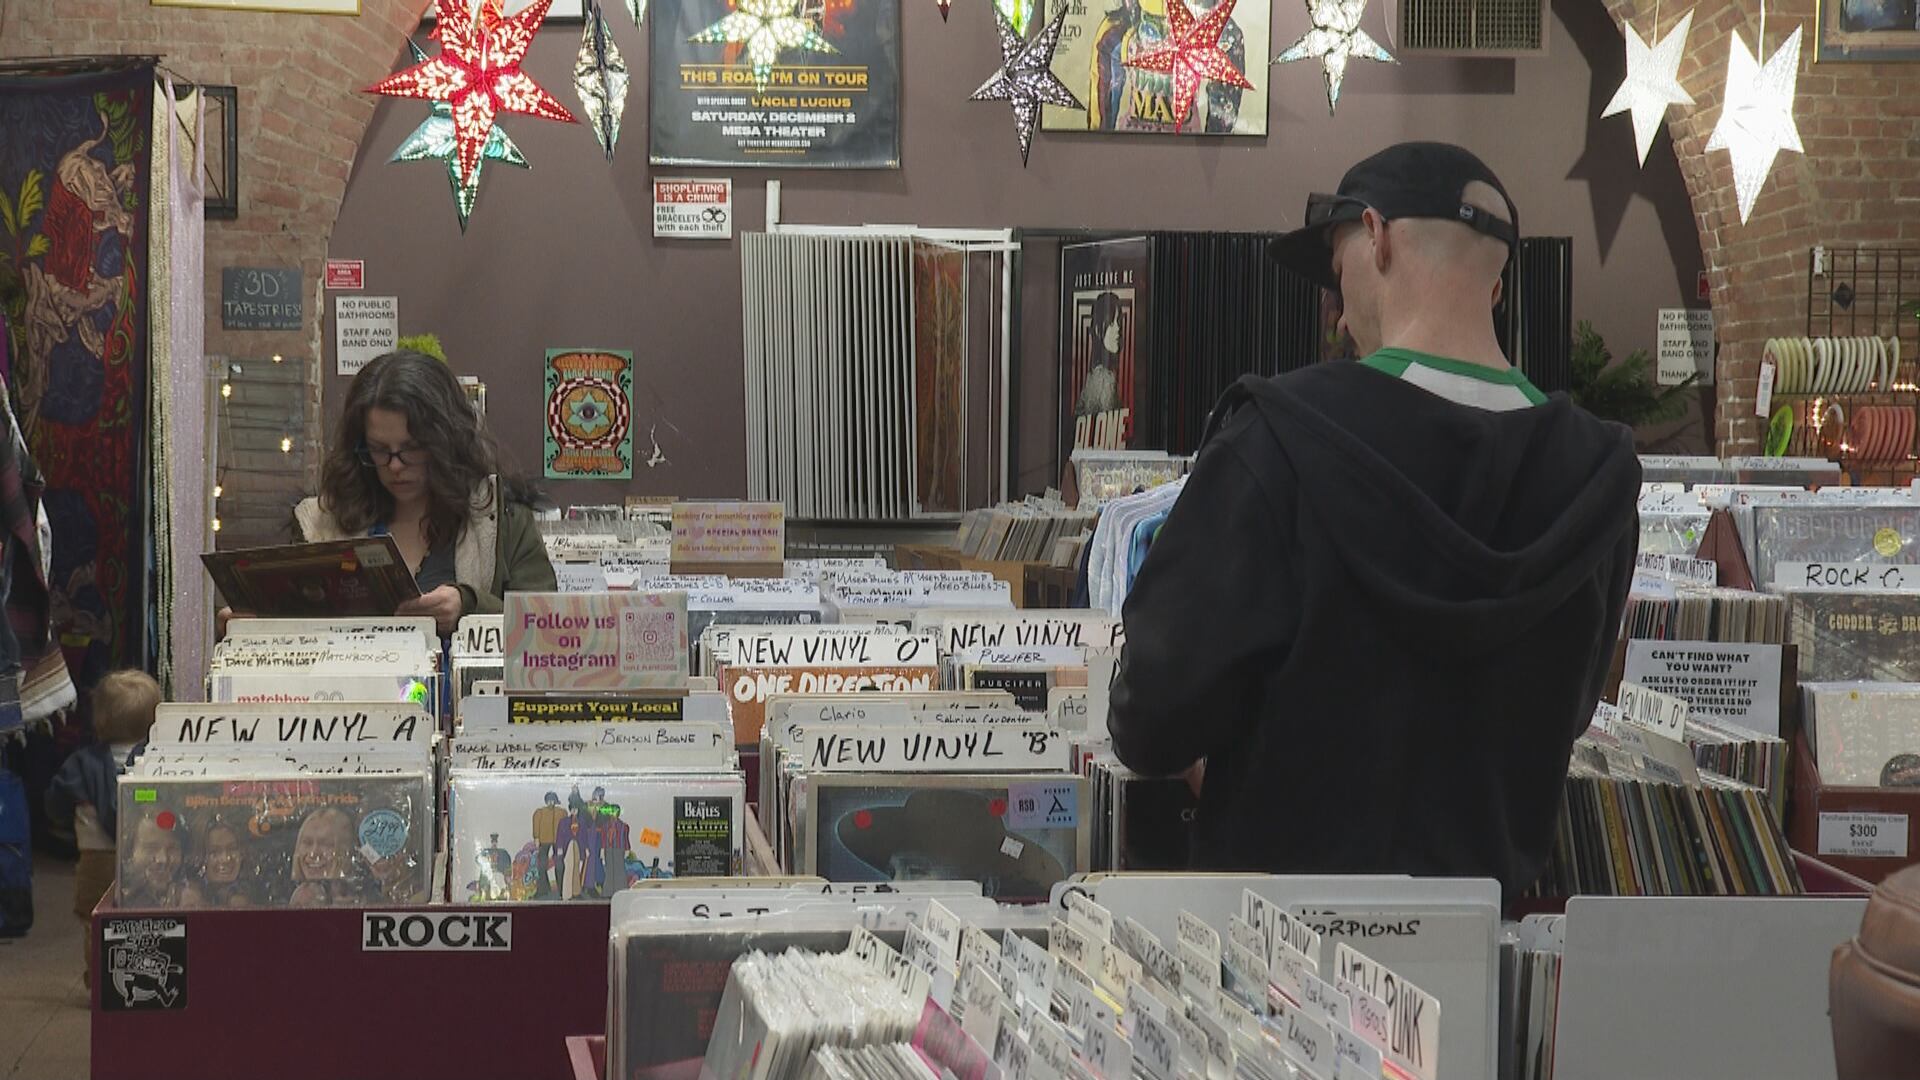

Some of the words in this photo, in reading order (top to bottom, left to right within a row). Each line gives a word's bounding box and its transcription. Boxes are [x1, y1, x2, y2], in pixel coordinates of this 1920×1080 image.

[680, 70, 717, 83] THIS
[722, 71, 766, 84] ROA
[771, 72, 793, 84] I'M
[798, 73, 820, 84] ON
[825, 73, 868, 85] TOUR
[801, 97, 851, 108] LUCIUS
[692, 112, 767, 123] SATURDAY,
[770, 112, 844, 123] DECEMBER
[722, 126, 761, 136] MESA
[764, 126, 825, 137] THEATER
[660, 184, 724, 193] SHOPLIFTING
[664, 194, 673, 202] IS
[676, 194, 683, 202] A
[687, 194, 719, 202] CRIME
[657, 214, 700, 222] BRACELETS
[244, 270, 280, 297] 3D
[1075, 273, 1091, 288] JUST
[1096, 271, 1118, 286] LEAVE
[1123, 270, 1133, 283] ME
[342, 301, 356, 309] NO
[359, 301, 391, 309] PUBLIC
[1663, 312, 1675, 320] NO
[1678, 312, 1709, 320] PUBLIC
[343, 328, 369, 336] STAFF
[373, 328, 391, 336] AND
[1660, 323, 1712, 331] BATHROOMS
[1074, 408, 1129, 450] ALONE
[1806, 564, 1869, 587] ROCK
[523, 612, 590, 630] Follow
[595, 615, 616, 630] us
[559, 635, 581, 648] on
[950, 624, 1005, 652] NEW
[1016, 623, 1088, 647] VINYL
[738, 637, 793, 664] NEW
[803, 636, 872, 663] VINYL
[1651, 650, 1685, 660] CAN'T
[1688, 651, 1714, 661] FIND
[1716, 652, 1750, 663] WHAT
[319, 651, 373, 663] MATCHBOX
[523, 653, 616, 672] Instagram
[979, 650, 1046, 664] PUSCIFER
[1666, 662, 1690, 672] YOU
[1692, 663, 1732, 673] WANT?
[1642, 676, 1660, 684] ASK
[1662, 676, 1675, 684] US
[1690, 678, 1722, 686] ORDER
[734, 675, 793, 704] ONE
[513, 702, 583, 714] Support
[586, 702, 628, 713] Your
[632, 702, 678, 713] Local
[1695, 697, 1725, 705] THERE
[1737, 698, 1751, 706] NO
[1709, 707, 1721, 715] TO
[178, 716, 260, 743] NEW
[279, 712, 378, 743] VINYL
[602, 728, 651, 745] BENSON
[656, 728, 696, 745] BOONE
[456, 744, 488, 753] BLACK
[496, 743, 531, 753] LABEL
[535, 742, 586, 754] SOCIETY
[812, 734, 885, 767] NEW
[904, 730, 1003, 761] VINYL
[1022, 731, 1059, 754] "B"
[472, 756, 495, 769] The
[505, 756, 561, 769] Beatles
[685, 802, 720, 820] BEATLES
[1850, 824, 1877, 837] $300
[366, 915, 508, 947] ROCK
[1305, 919, 1420, 938] ORPIONS
